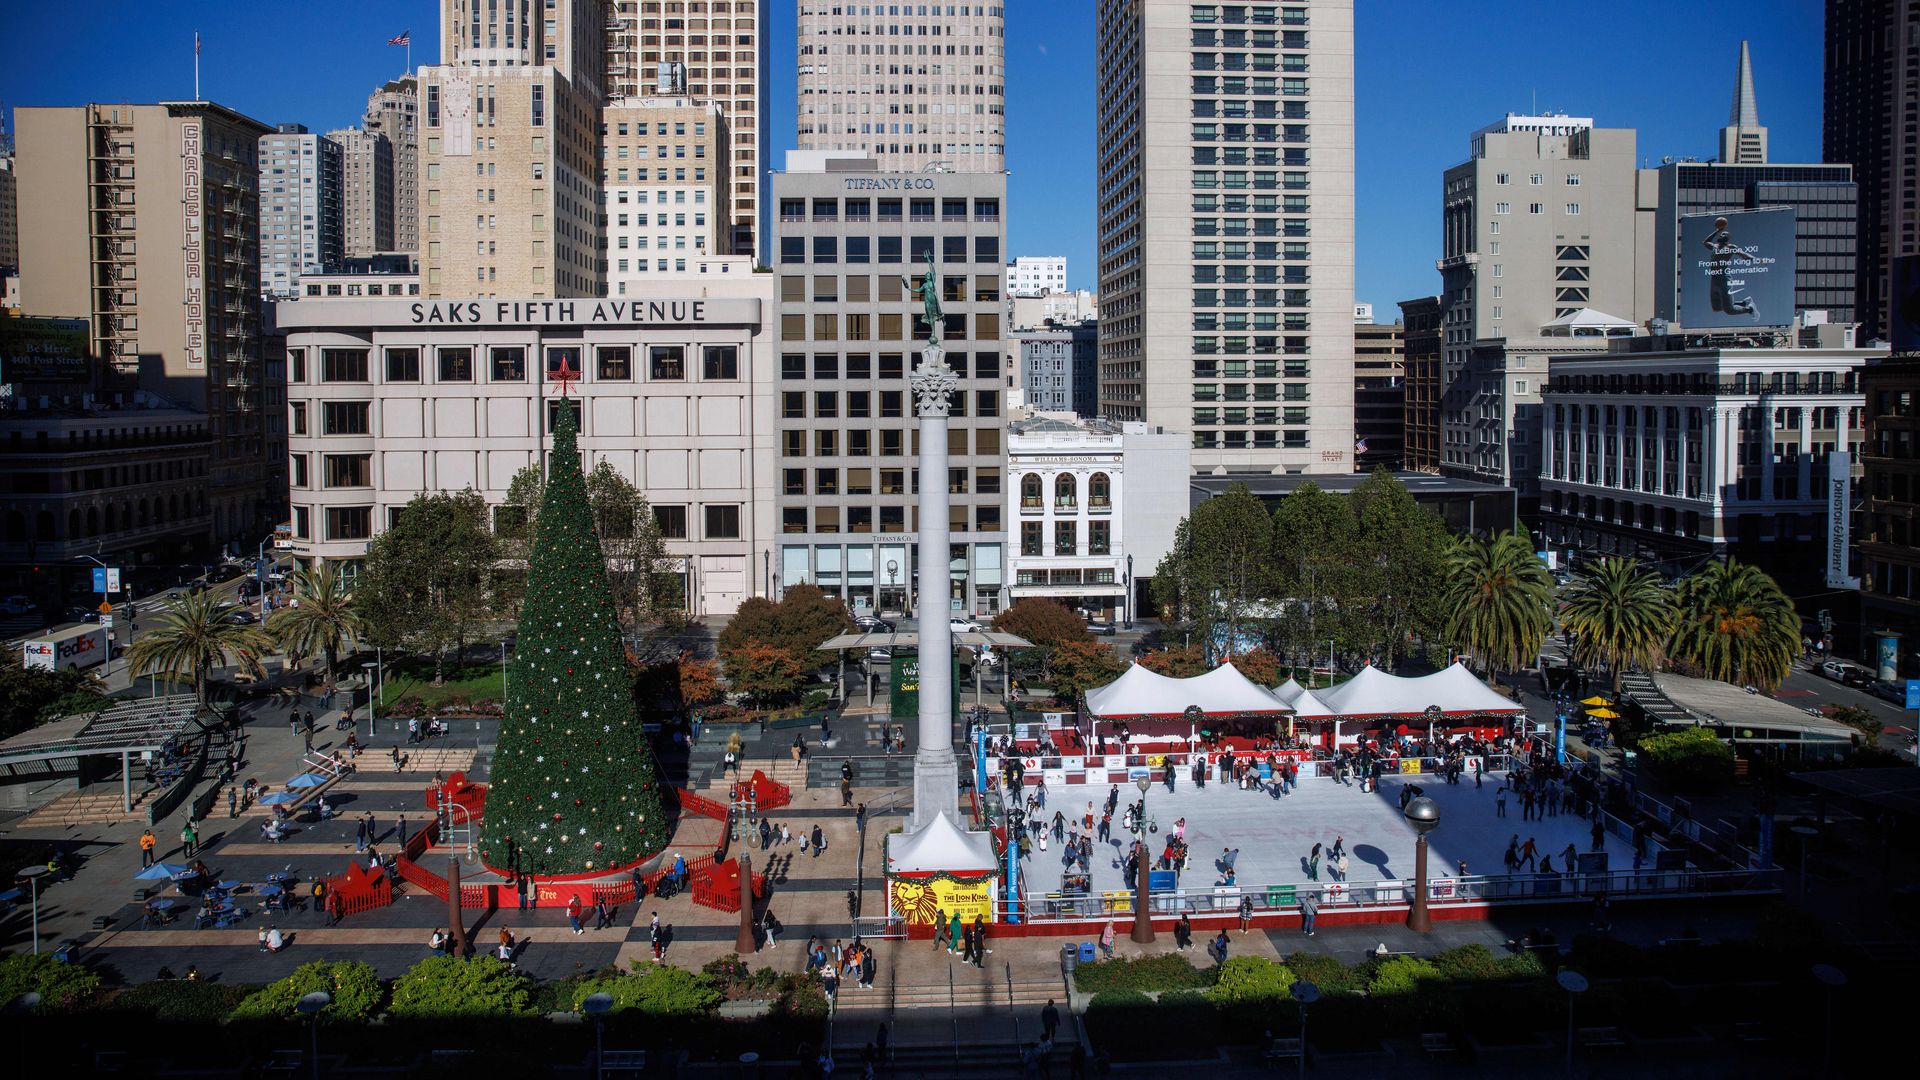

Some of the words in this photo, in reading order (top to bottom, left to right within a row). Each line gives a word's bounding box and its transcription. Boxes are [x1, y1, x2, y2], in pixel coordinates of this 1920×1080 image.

[845, 178, 902, 190] TIFFANY
[904, 179, 913, 190] &
[184, 124, 200, 278] CHANCELLOR
[1714, 246, 1743, 255] LeBron
[1698, 260, 1718, 268] From
[1719, 259, 1732, 267] the
[1733, 258, 1751, 267] King
[1704, 268, 1723, 276] Next
[1724, 266, 1769, 275] Generation
[411, 302, 481, 323] SAKS
[497, 302, 575, 323] FIFTH
[592, 301, 705, 322] AVENUE
[47, 321, 80, 331] Square
[186, 288, 202, 364] HOTEL
[25, 343, 41, 353] Be
[43, 343, 71, 353] Here
[32, 355, 54, 365] Post
[56, 355, 85, 365] Street
[26, 645, 52, 655] FedEx
[57, 635, 95, 660] FedEx
[540, 888, 557, 901] Tree
[956, 894, 970, 902] LION
[972, 894, 988, 902] KING
